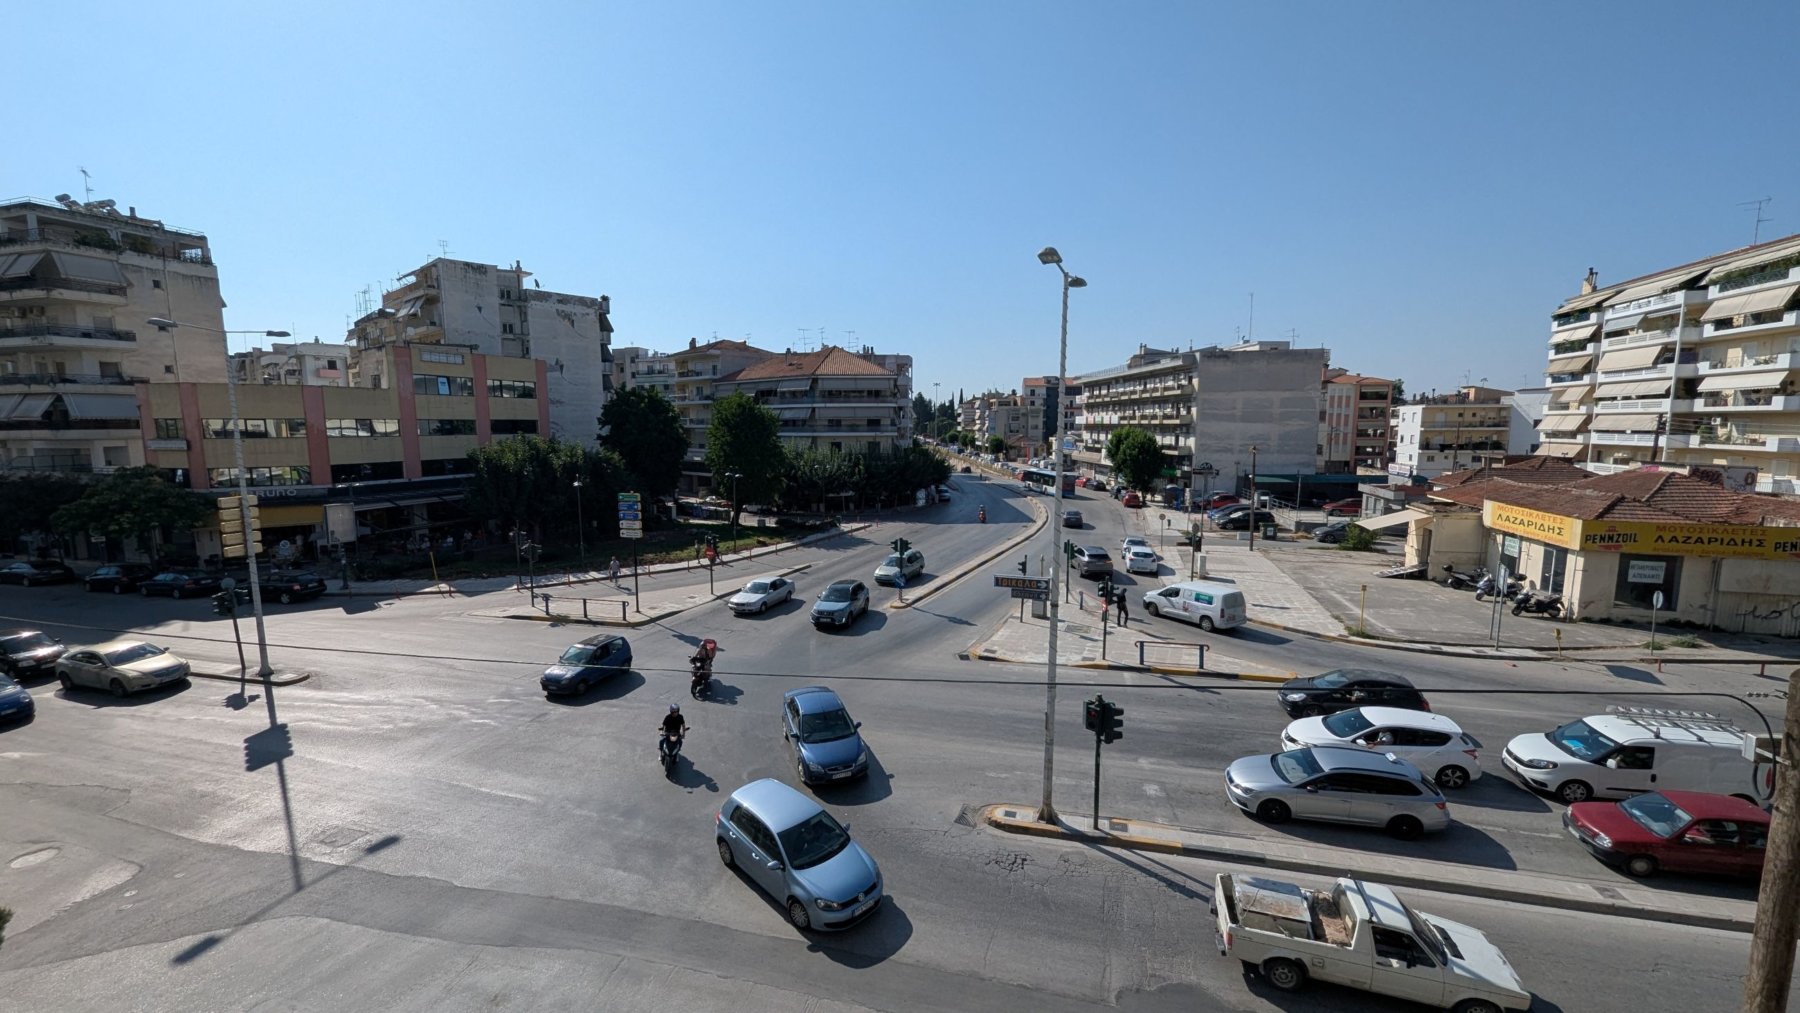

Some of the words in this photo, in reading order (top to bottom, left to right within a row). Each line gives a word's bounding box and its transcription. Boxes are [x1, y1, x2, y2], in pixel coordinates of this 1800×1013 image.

[1497, 504, 1566, 525] ΜΟΤΟΣΙΚΛΕΤΕΣ
[1496, 514, 1565, 536] ΛΑΖΑΡΙΔΗΣ
[1655, 525, 1768, 536] ΜΟΤΟΣΙΚΛΕΤΕΣ
[1584, 533, 1640, 544] PENNZOIL
[1654, 535, 1766, 547] ΛΑΖΑΡΙΔΗΣ
